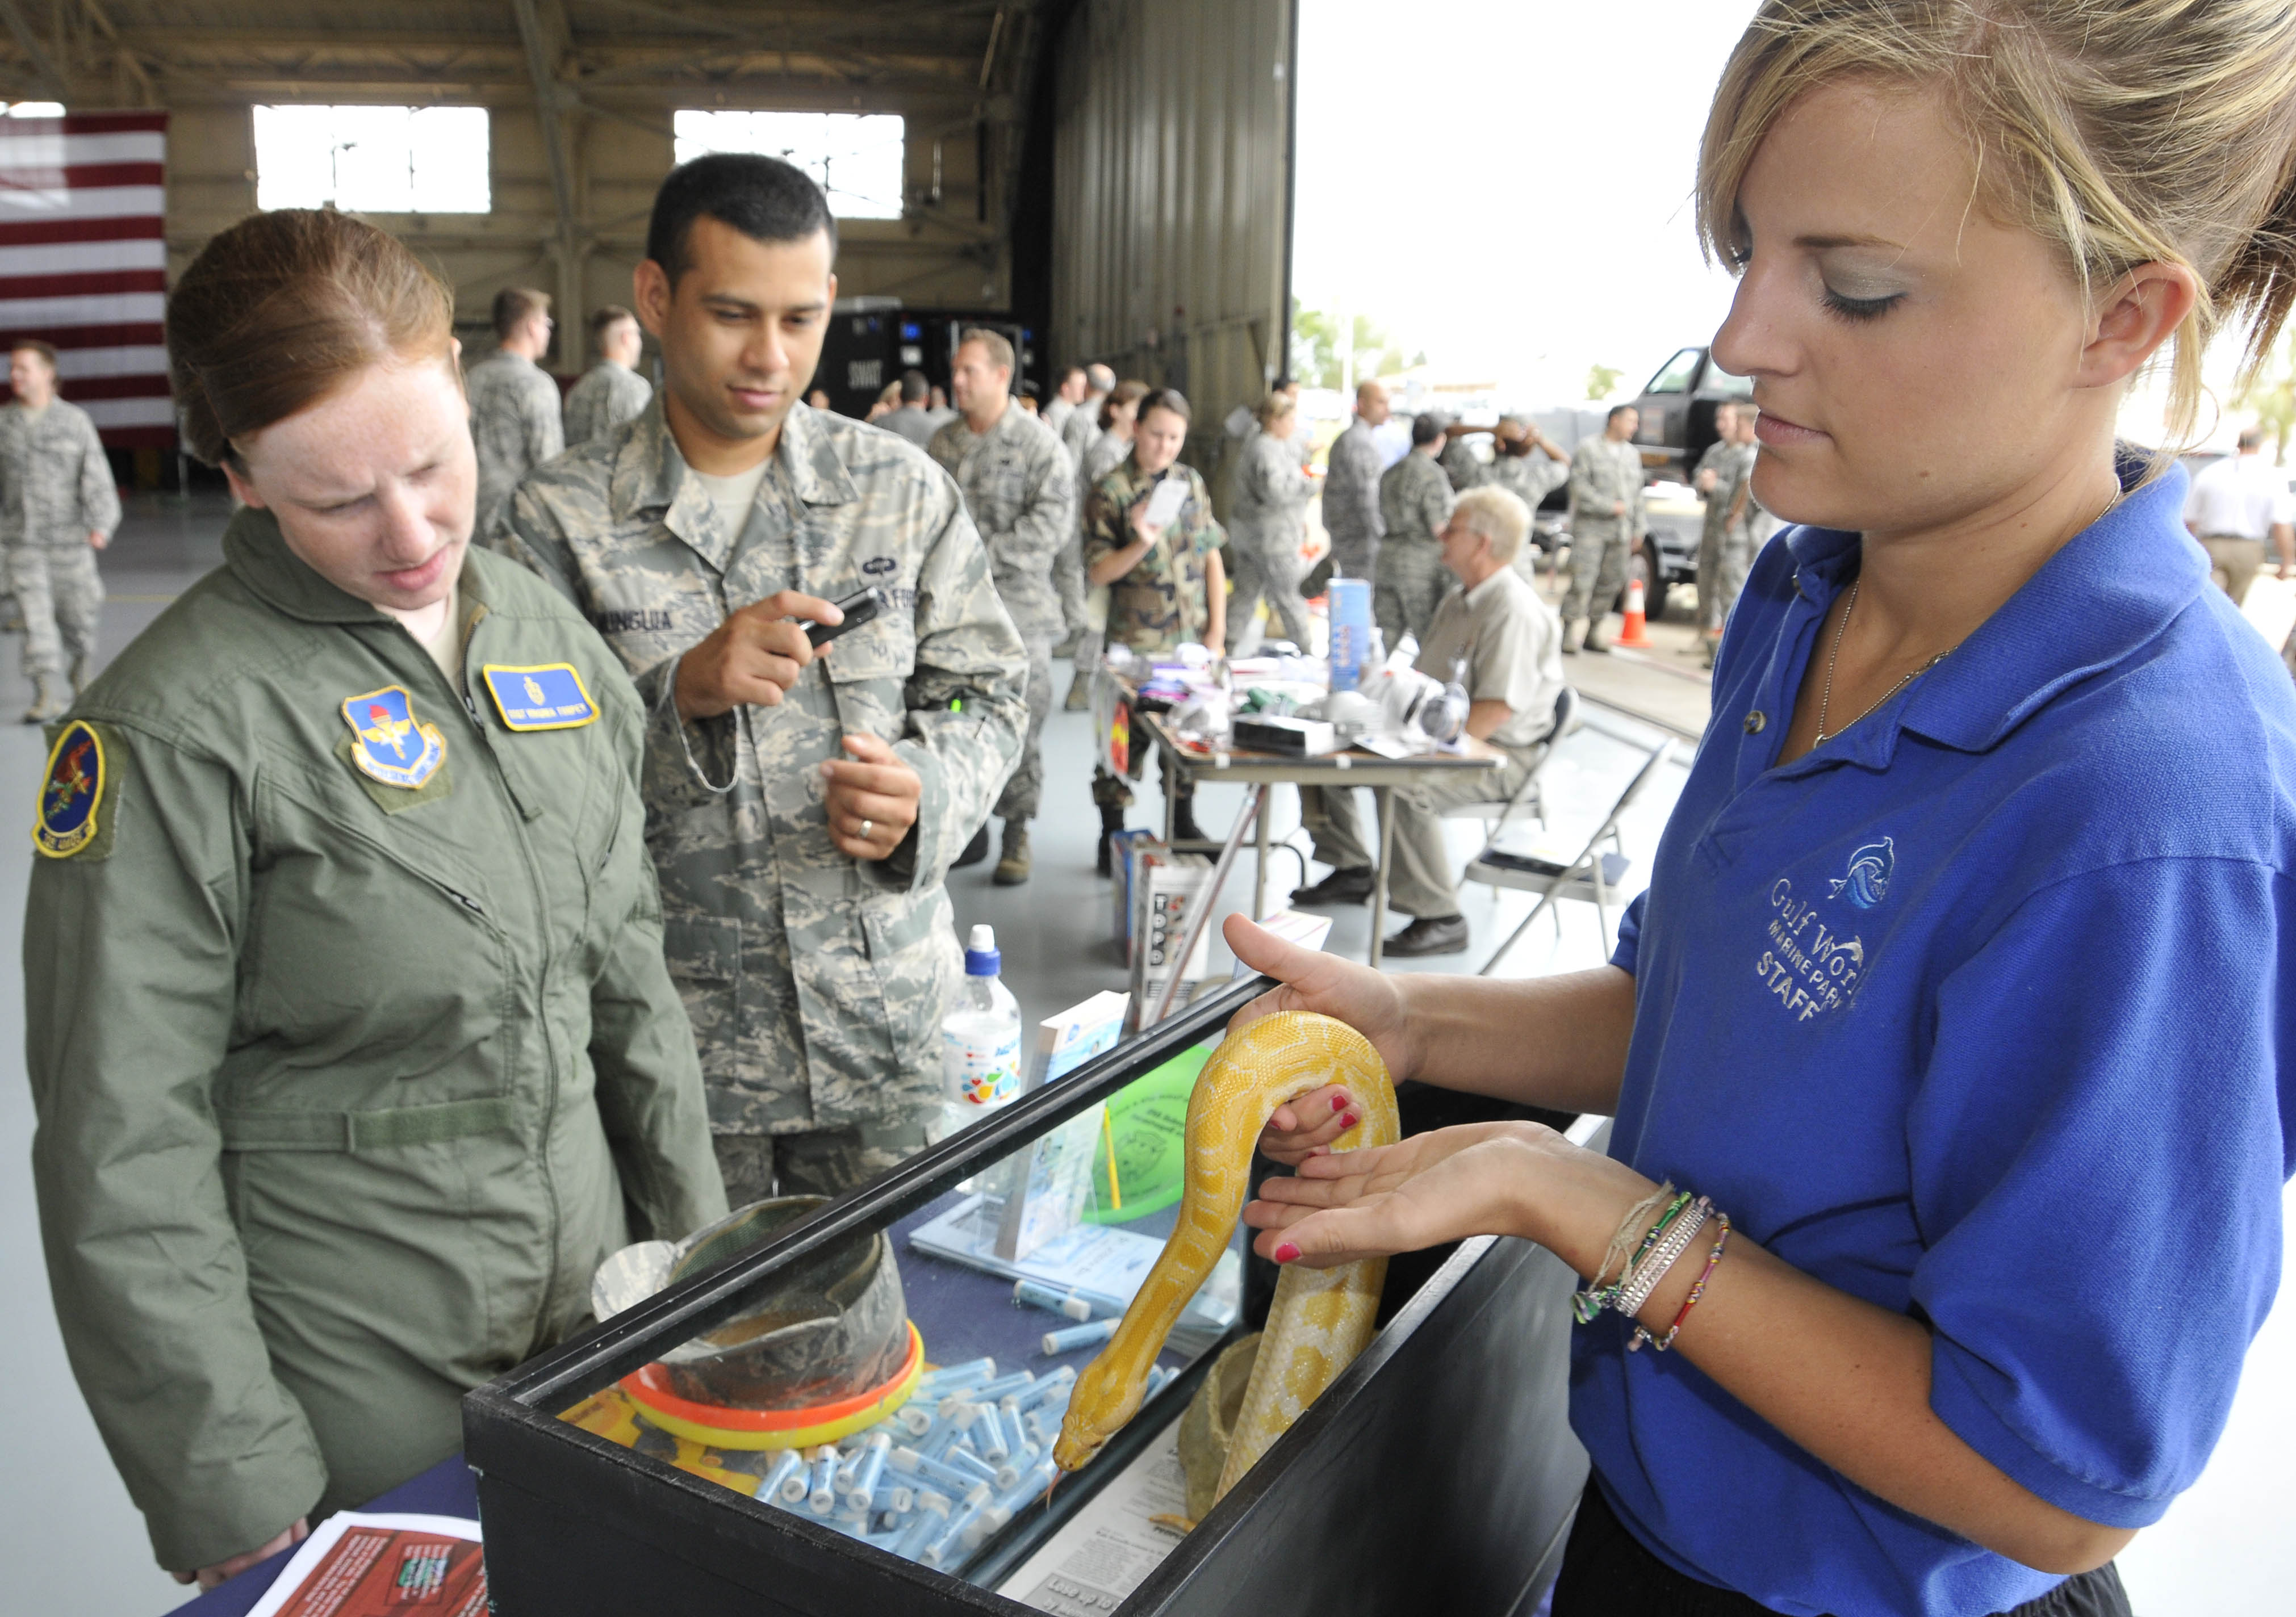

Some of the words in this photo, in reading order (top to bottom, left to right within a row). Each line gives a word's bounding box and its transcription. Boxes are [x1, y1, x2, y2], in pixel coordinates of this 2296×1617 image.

[1771, 878, 1817, 936] Gulf
[1768, 919, 1812, 975] MARINE
[1757, 951, 1821, 1021] STAFF
